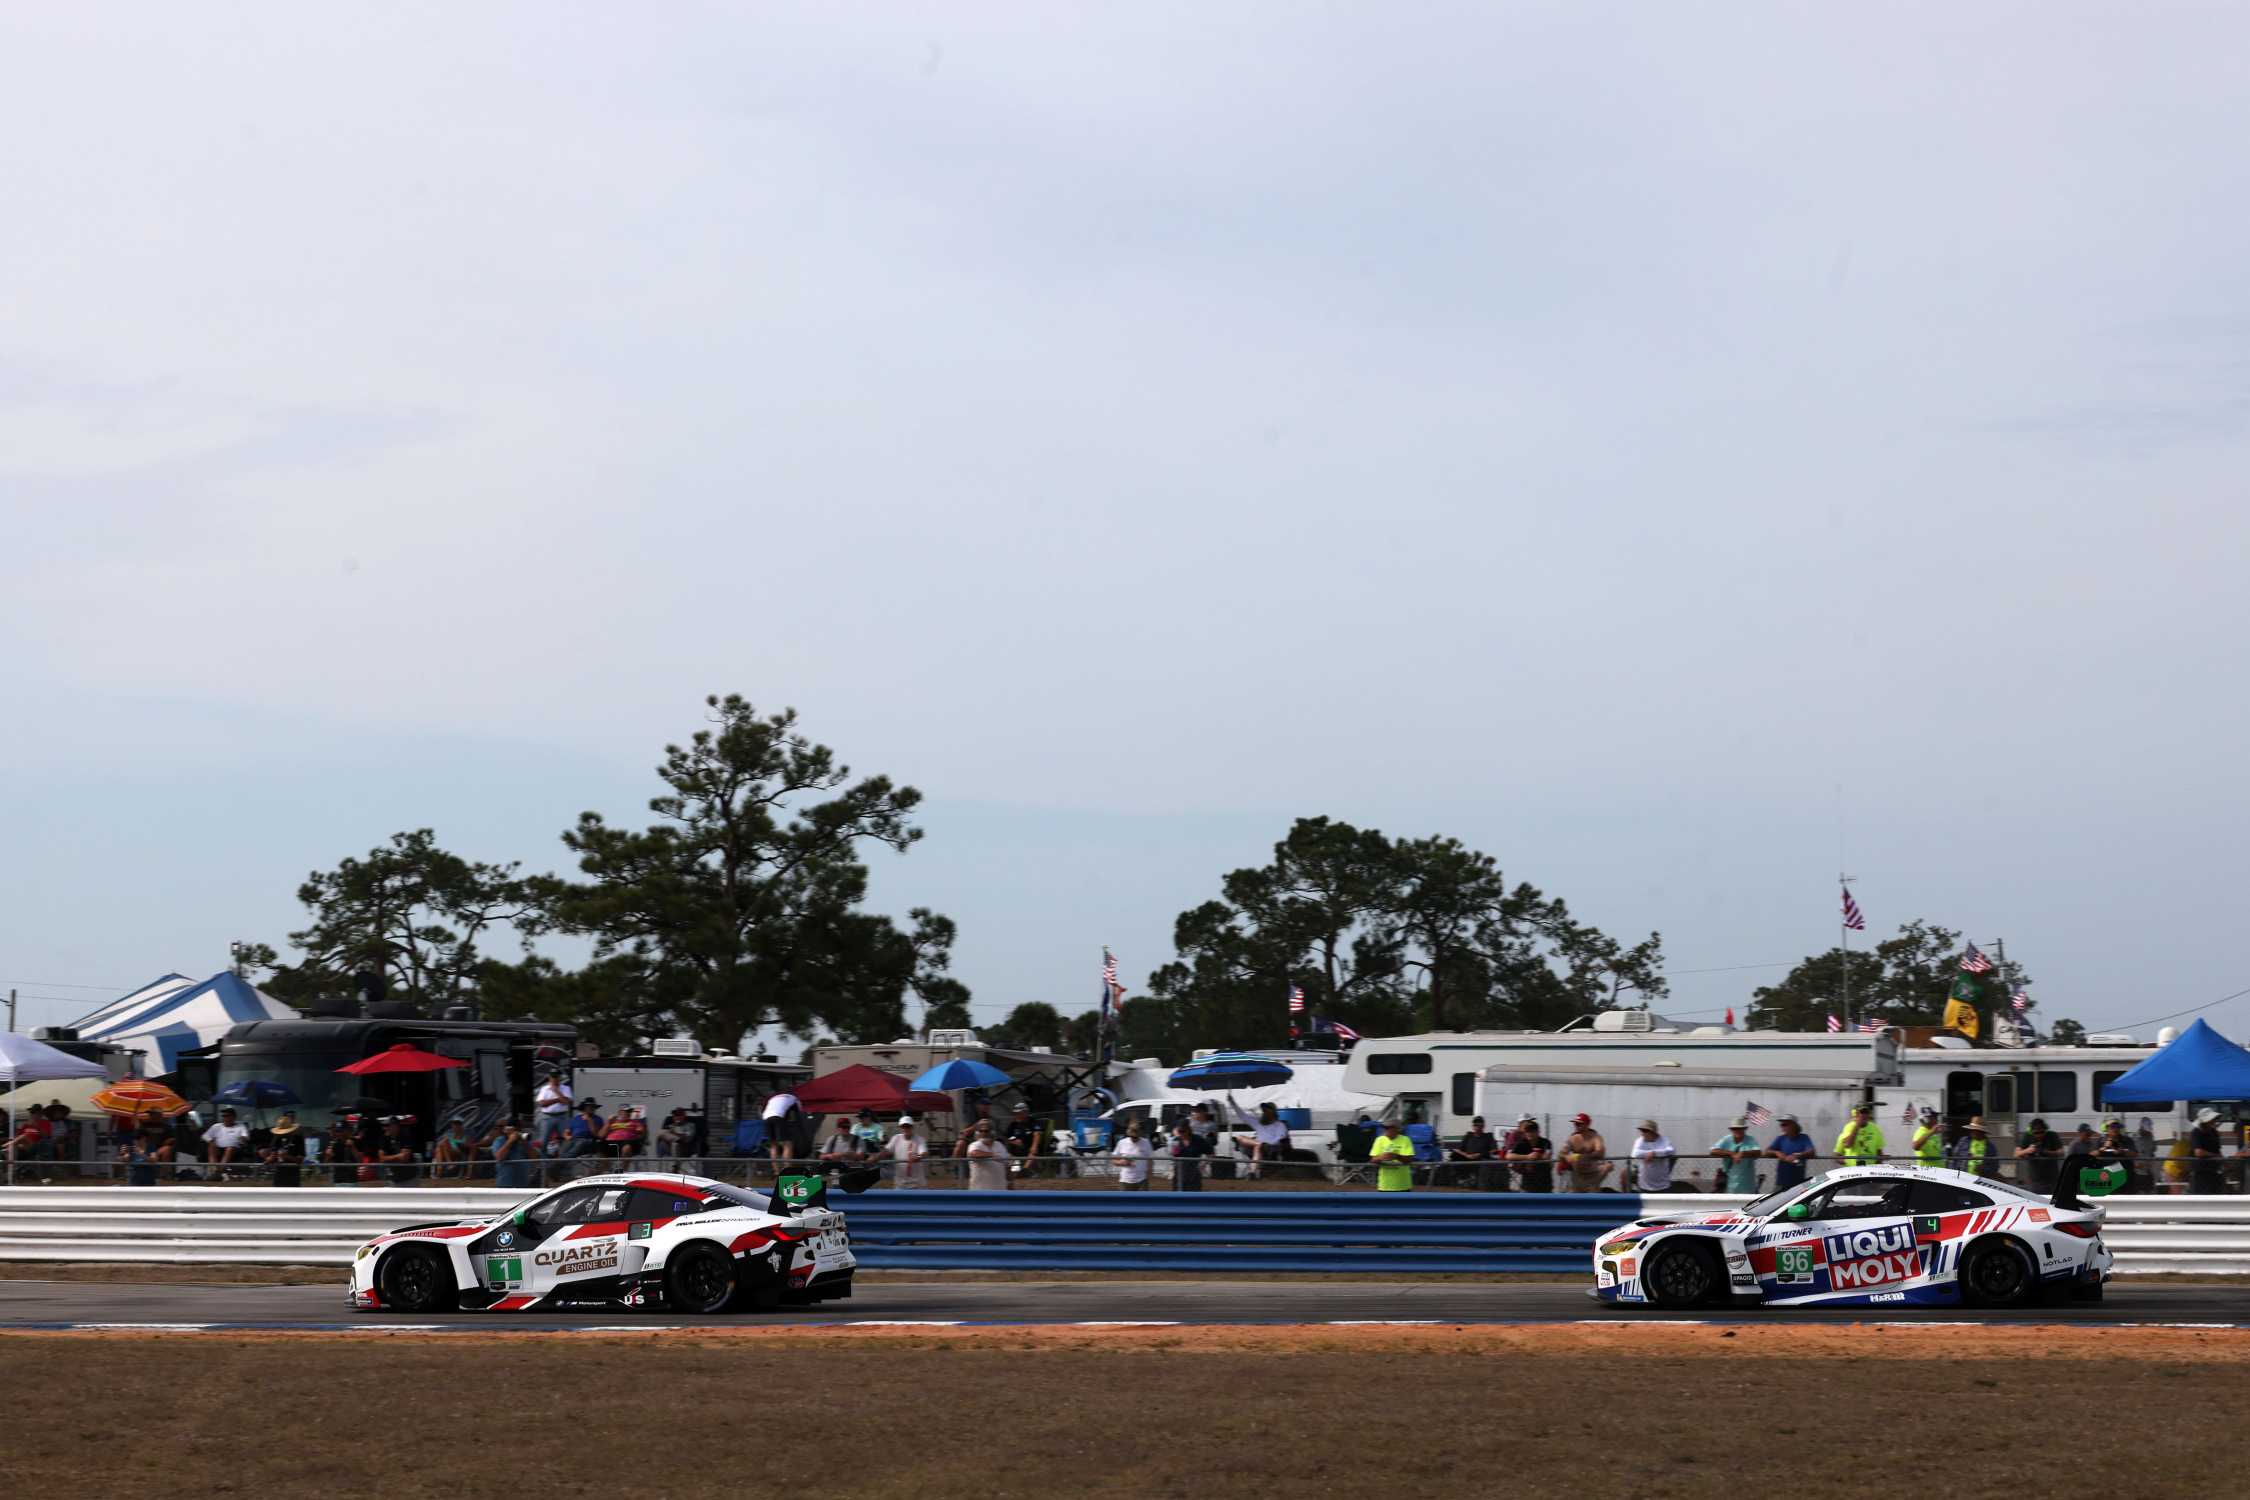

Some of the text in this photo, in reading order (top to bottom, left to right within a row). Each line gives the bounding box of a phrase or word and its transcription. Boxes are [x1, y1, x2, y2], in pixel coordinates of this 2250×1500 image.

[641, 1223, 651, 1239] 3
[1781, 1227, 1813, 1240] TURNER
[1927, 1219, 1937, 1232] 4
[534, 1241, 618, 1266] QUARTZ
[1829, 1225, 1912, 1261] LIQUI
[499, 1260, 510, 1281] 1
[565, 1259, 615, 1273] ENGINE OIL
[1782, 1251, 1809, 1272] 96
[1833, 1251, 1916, 1289] MOLY
